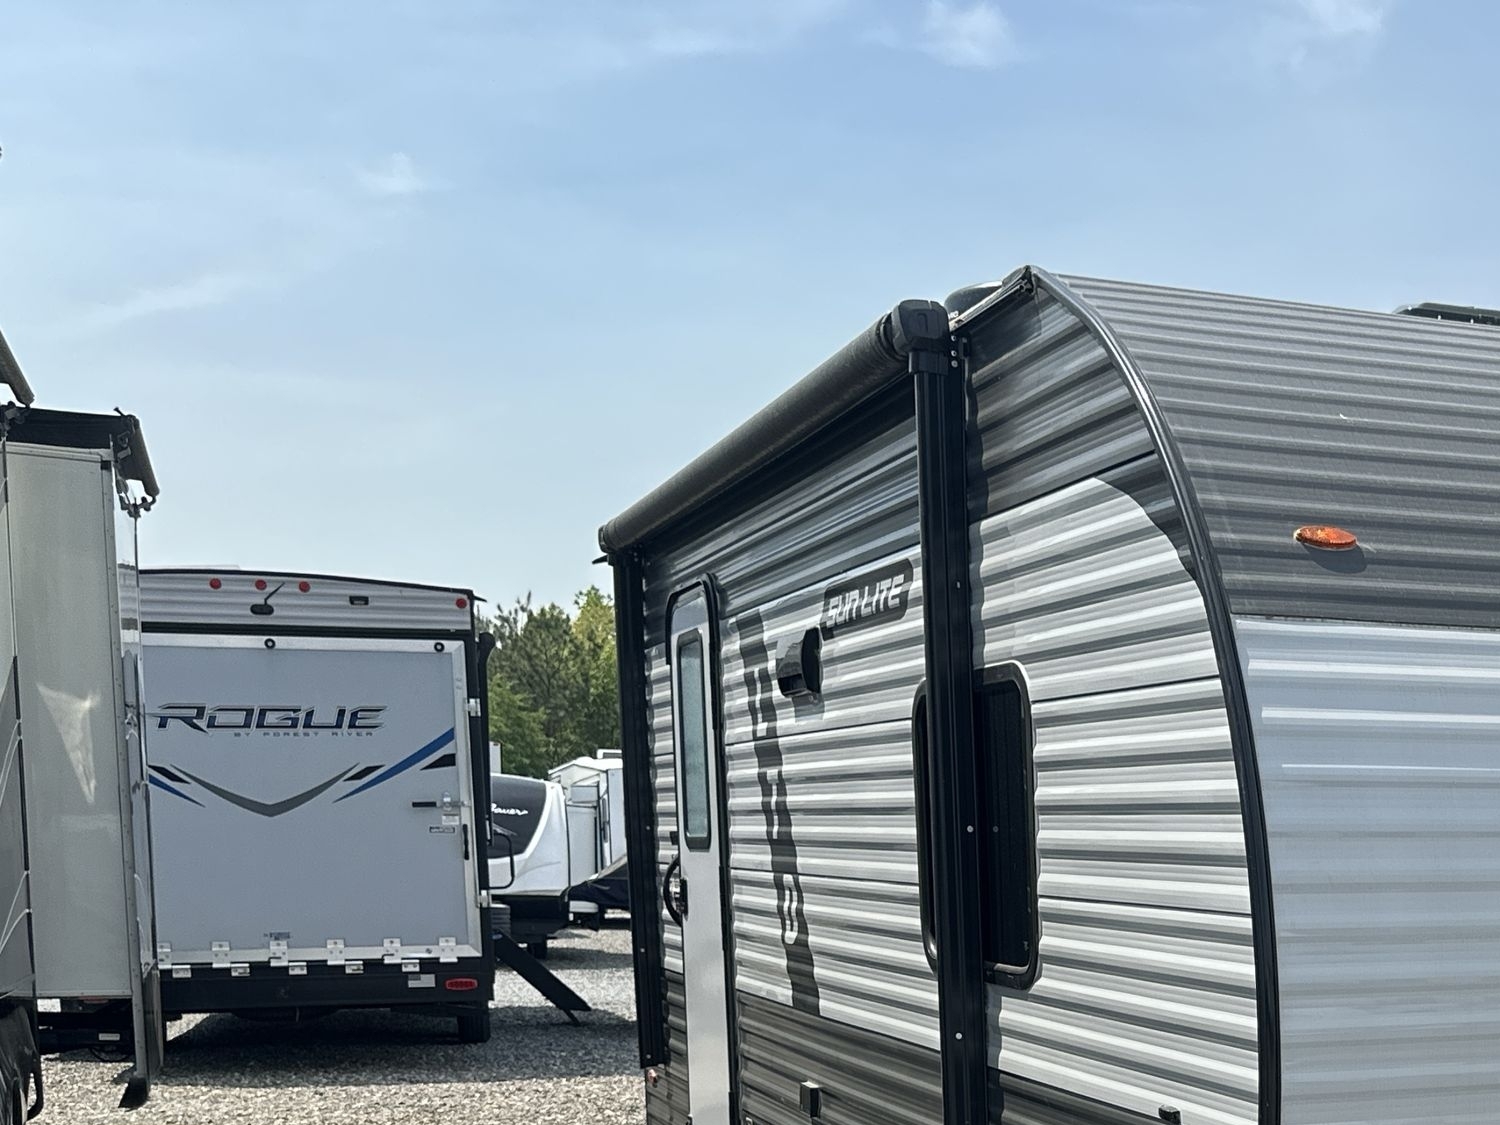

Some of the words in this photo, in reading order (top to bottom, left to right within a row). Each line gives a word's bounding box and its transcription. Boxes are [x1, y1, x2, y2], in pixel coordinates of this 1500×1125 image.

[825, 590, 860, 628] SUN
[861, 574, 905, 618] LITE
[148, 702, 388, 735] ROGUE
